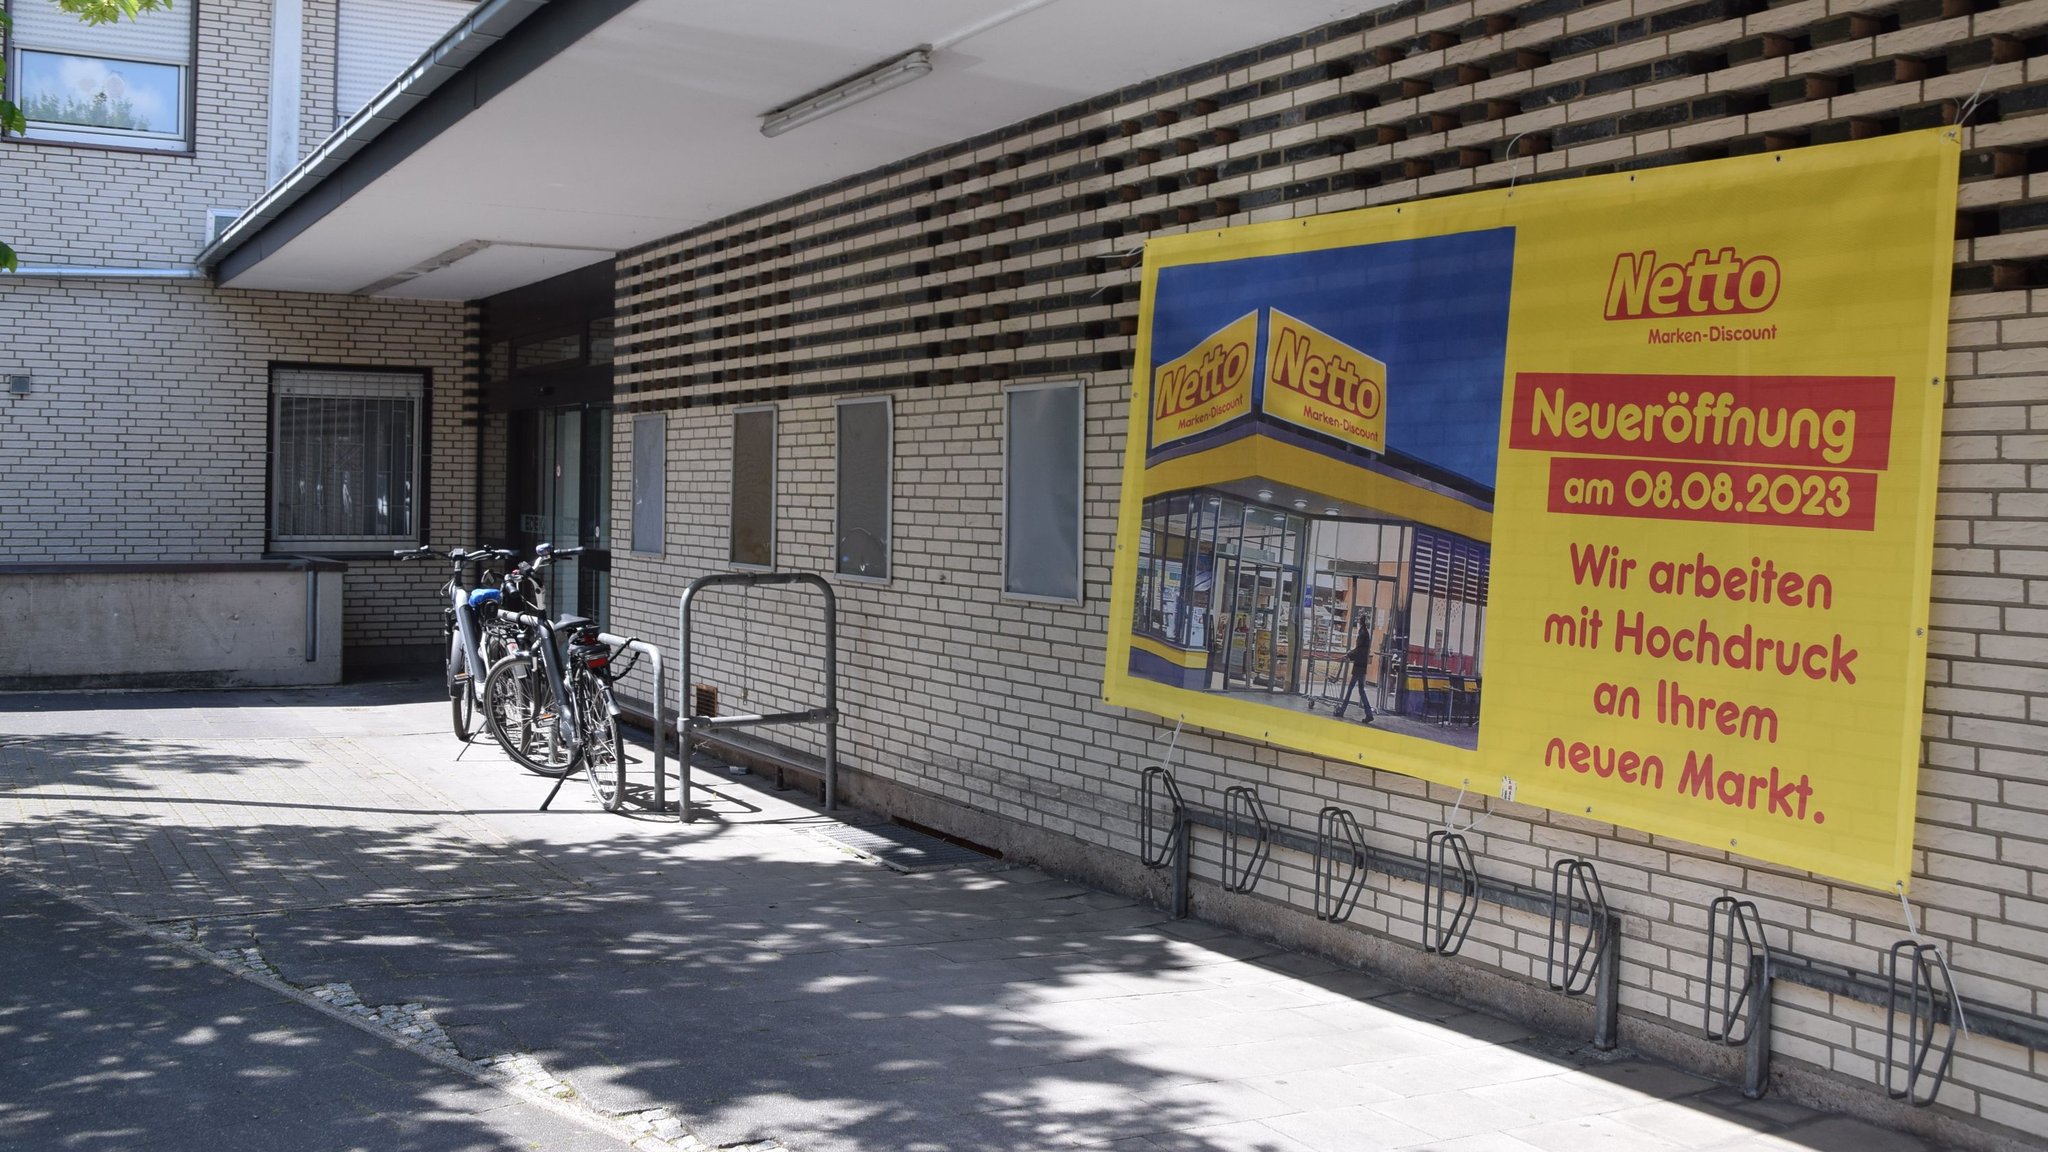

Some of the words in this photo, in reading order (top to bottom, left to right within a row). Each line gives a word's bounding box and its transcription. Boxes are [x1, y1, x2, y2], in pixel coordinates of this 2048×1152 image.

[1604, 246, 1780, 321] Netto
[1648, 325, 1777, 344] Marken-Discount
[1155, 342, 1249, 420] Netto
[1271, 327, 1381, 419] Netto
[1178, 393, 1244, 430] Marken-Discount
[1303, 405, 1379, 442] Marken-Discount
[1531, 387, 1856, 464] Neueröffnung
[1564, 478, 1614, 505] am
[1625, 470, 1851, 517] 08.08.2023
[1570, 543, 1637, 590] Wir
[1649, 552, 1832, 610] arbeiten
[1544, 606, 1603, 649] mit
[1615, 609, 1859, 685] Hochdruck
[1593, 682, 1640, 720] an
[1657, 679, 1778, 743] Ihrem
[1545, 737, 1664, 789] neuen
[1678, 751, 1825, 825] Markt.
